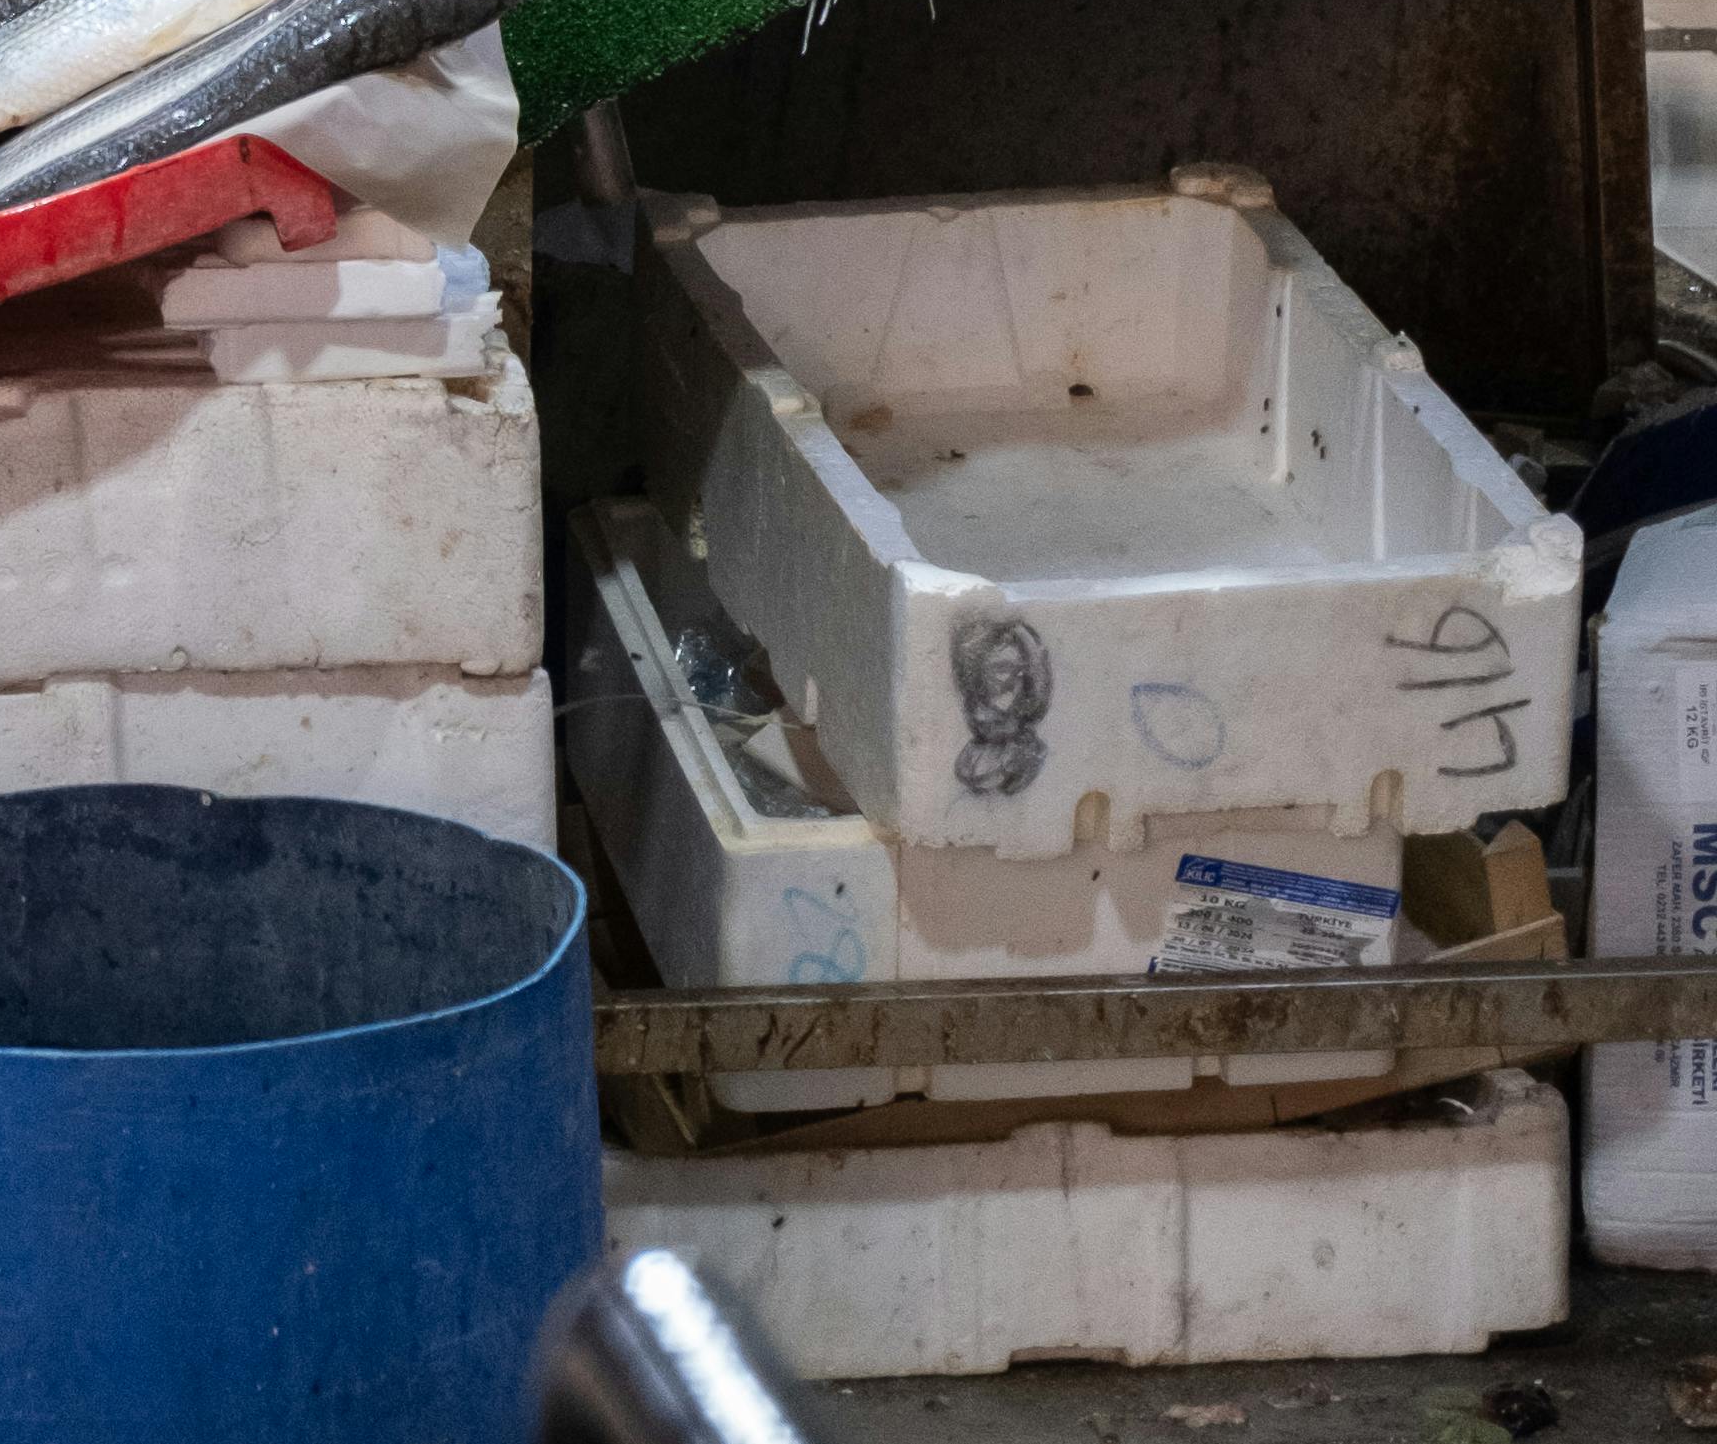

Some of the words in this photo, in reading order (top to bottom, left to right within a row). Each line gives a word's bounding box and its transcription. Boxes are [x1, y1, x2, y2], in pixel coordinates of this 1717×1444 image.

[1686, 706, 1698, 722] 12
[1686, 727, 1699, 749] KG
[1692, 824, 1717, 939] MSC
[1692, 1038, 1709, 1105] İRKETİ
